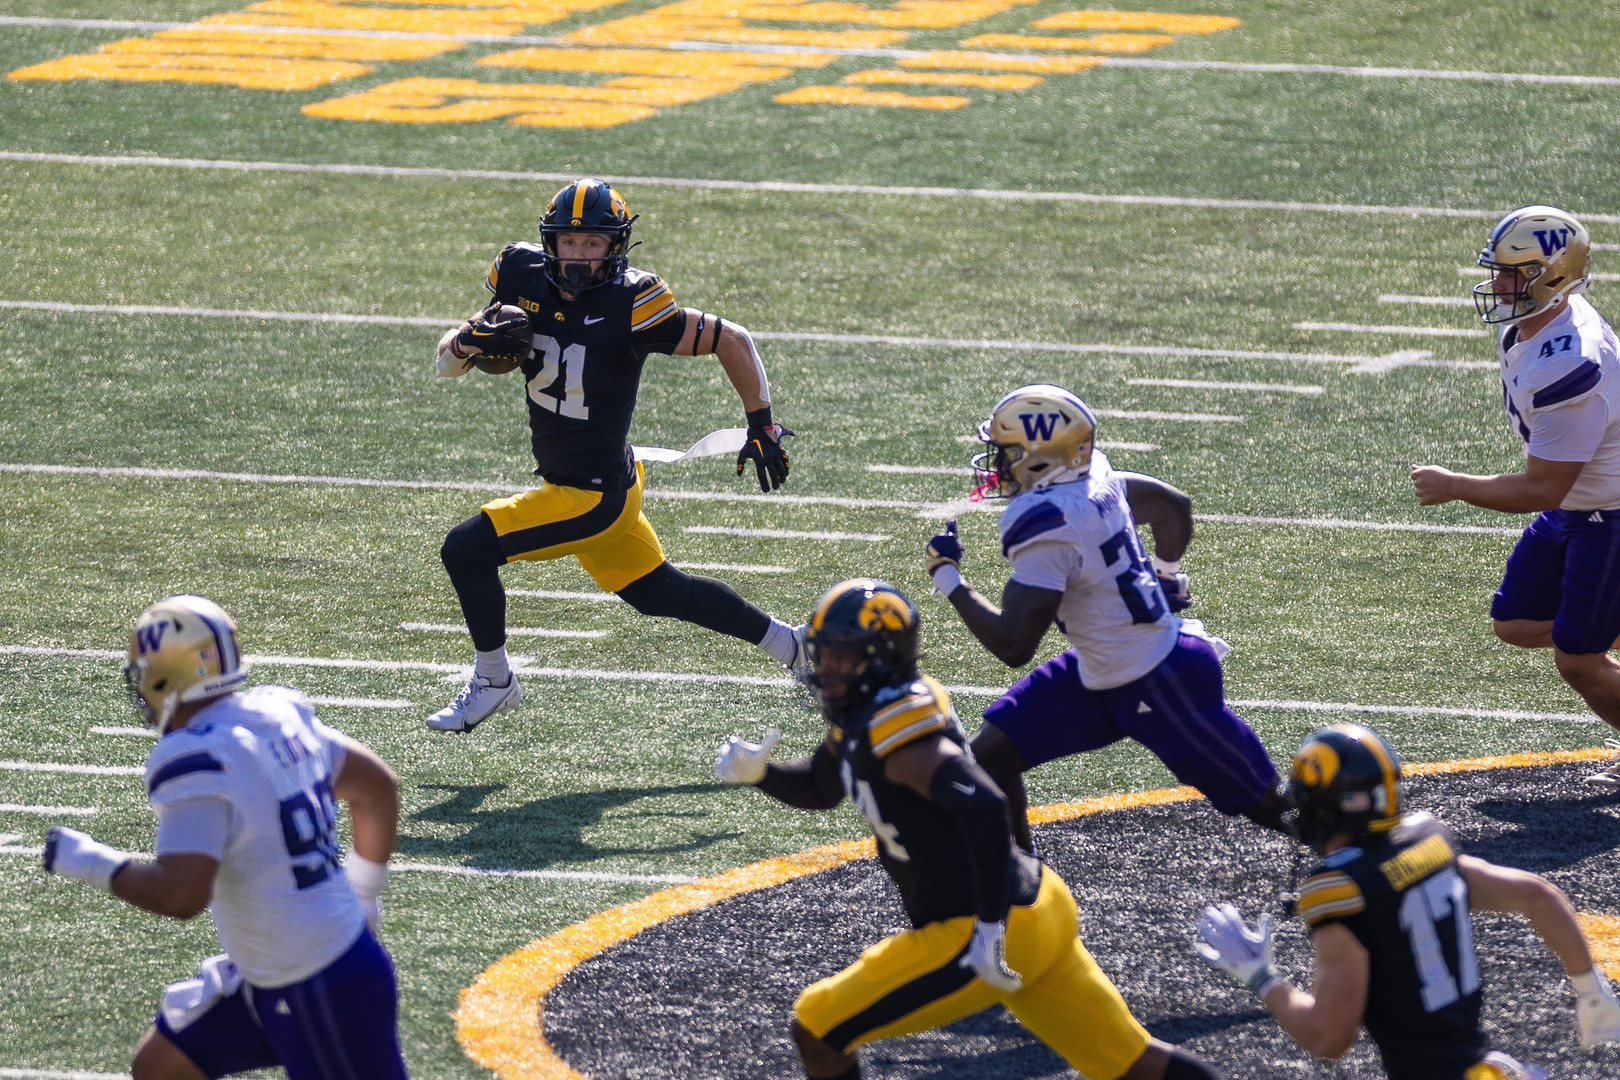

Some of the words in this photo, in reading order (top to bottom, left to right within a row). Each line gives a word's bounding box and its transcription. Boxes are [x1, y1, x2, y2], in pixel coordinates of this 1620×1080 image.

[1533, 228, 1570, 257] W
[1538, 334, 1572, 359] 47
[527, 333, 589, 421] 21
[1018, 412, 1060, 442] W
[1099, 527, 1166, 626] 2
[137, 620, 169, 656] W
[1398, 867, 1480, 1014] 17
